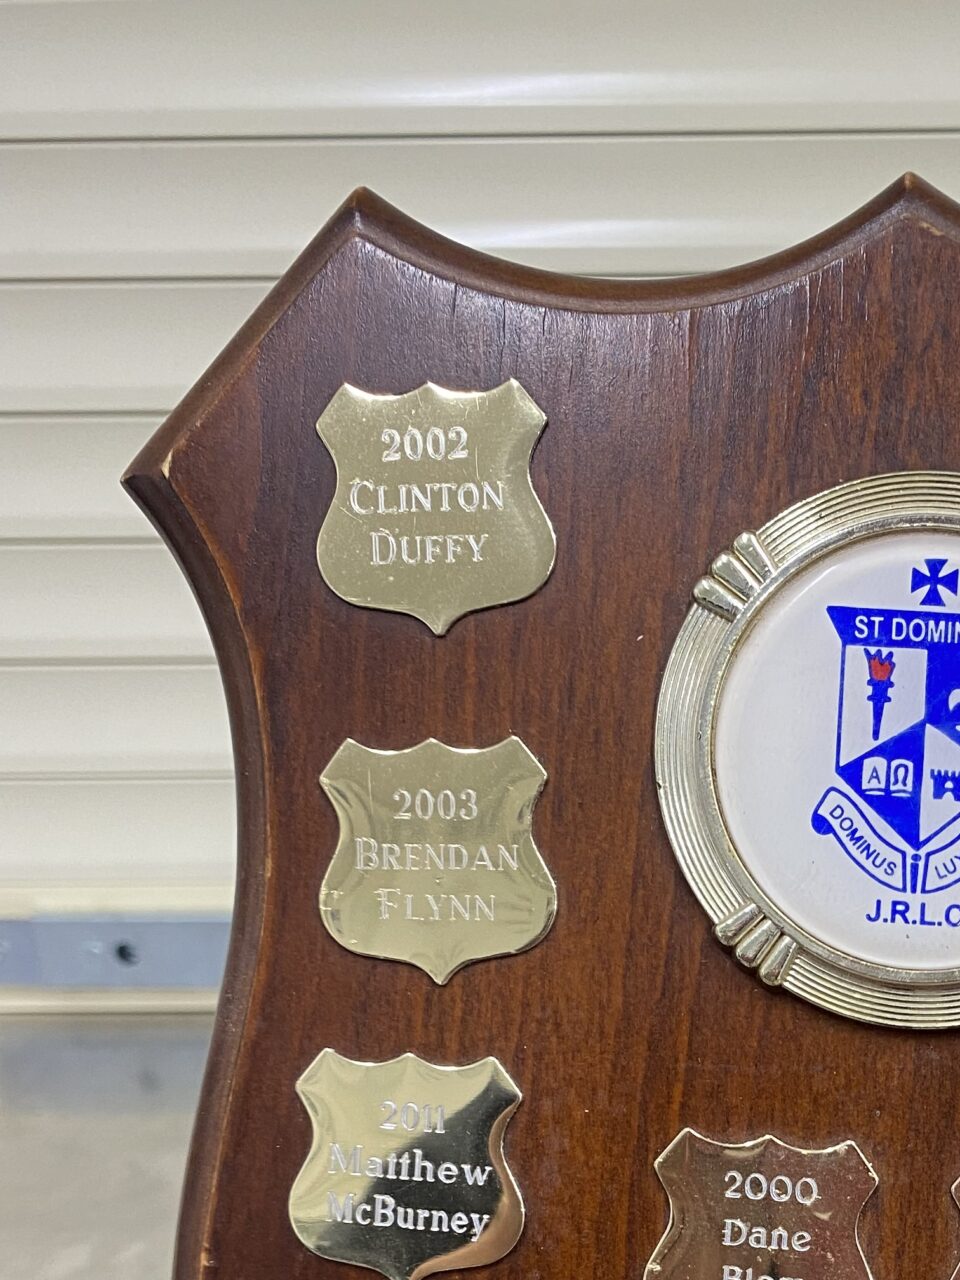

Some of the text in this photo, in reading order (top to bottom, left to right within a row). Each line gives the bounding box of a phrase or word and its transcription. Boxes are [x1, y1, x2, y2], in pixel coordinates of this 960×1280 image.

[381, 426, 469, 462] 2002
[350, 478, 505, 515] CLINTON
[370, 529, 488, 565] DUFFY
[854, 615, 884, 639] ST
[393, 789, 478, 820] 2003
[354, 838, 519, 871] BRENDAN
[829, 804, 897, 877] DOMINUS
[373, 888, 495, 921] FLYNN
[379, 1100, 446, 1134] 2011
[328, 1143, 493, 1186] Matthew
[724, 1170, 818, 1204] 2000
[326, 1191, 490, 1241] McBurney
[722, 1218, 811, 1251] Dane
